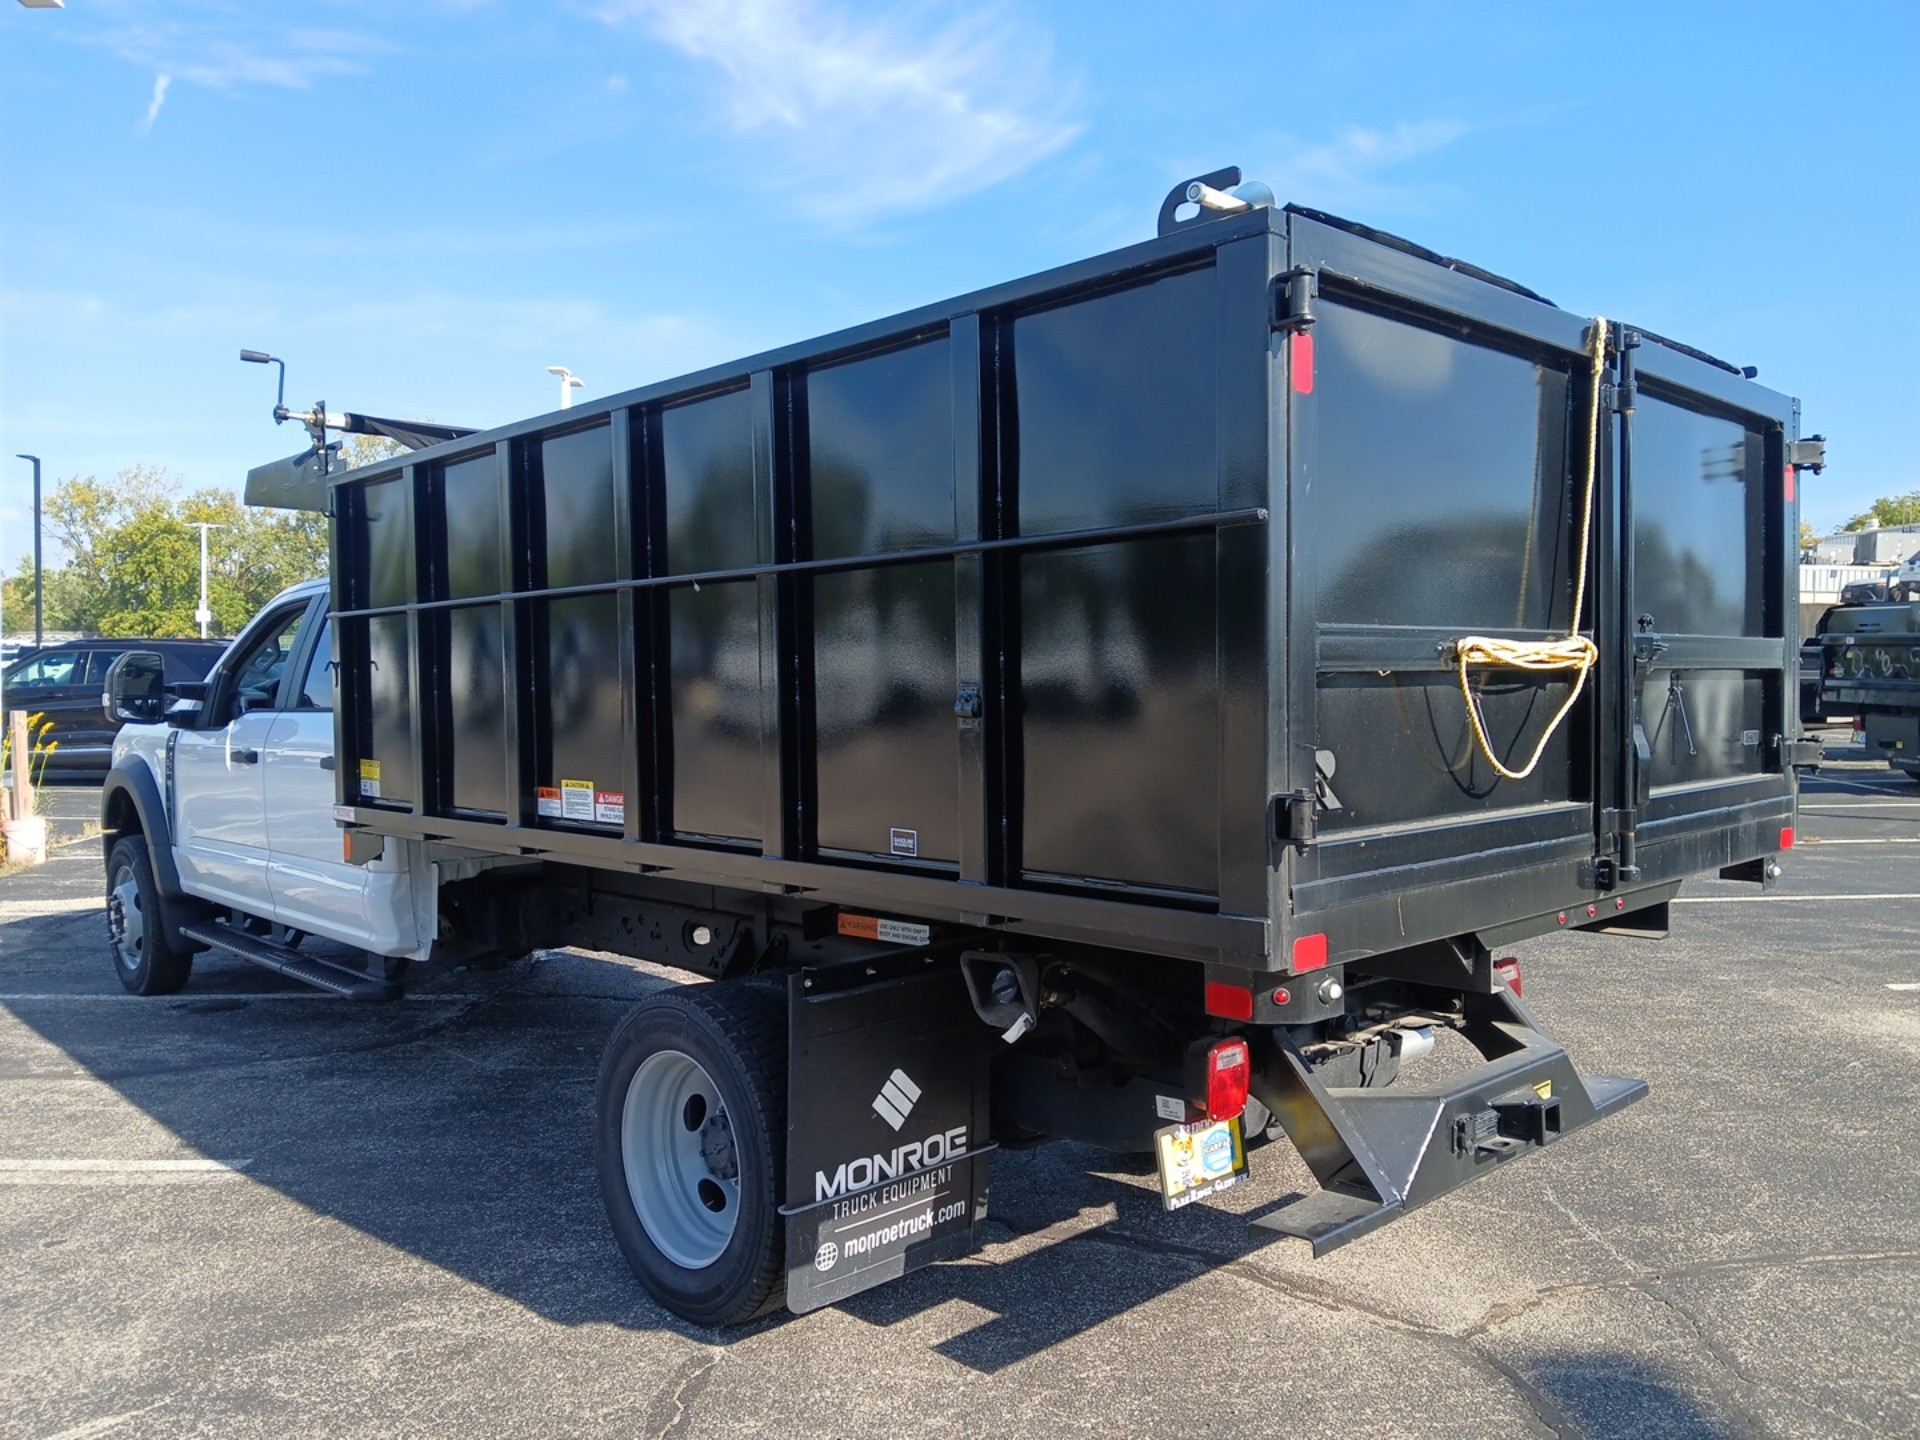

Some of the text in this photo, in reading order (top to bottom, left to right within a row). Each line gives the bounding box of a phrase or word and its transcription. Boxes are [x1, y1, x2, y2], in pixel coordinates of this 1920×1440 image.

[605, 793, 624, 804] DANGE
[879, 930, 891, 938] BODY
[902, 934, 918, 942] ENGINE
[889, 924, 900, 932] ONLY
[913, 927, 928, 935] EMPTY
[815, 1125, 967, 1202] MONROE
[833, 1165, 954, 1221] TRUCK EQUIPMENT
[844, 1199, 966, 1259] monroetruck.com
